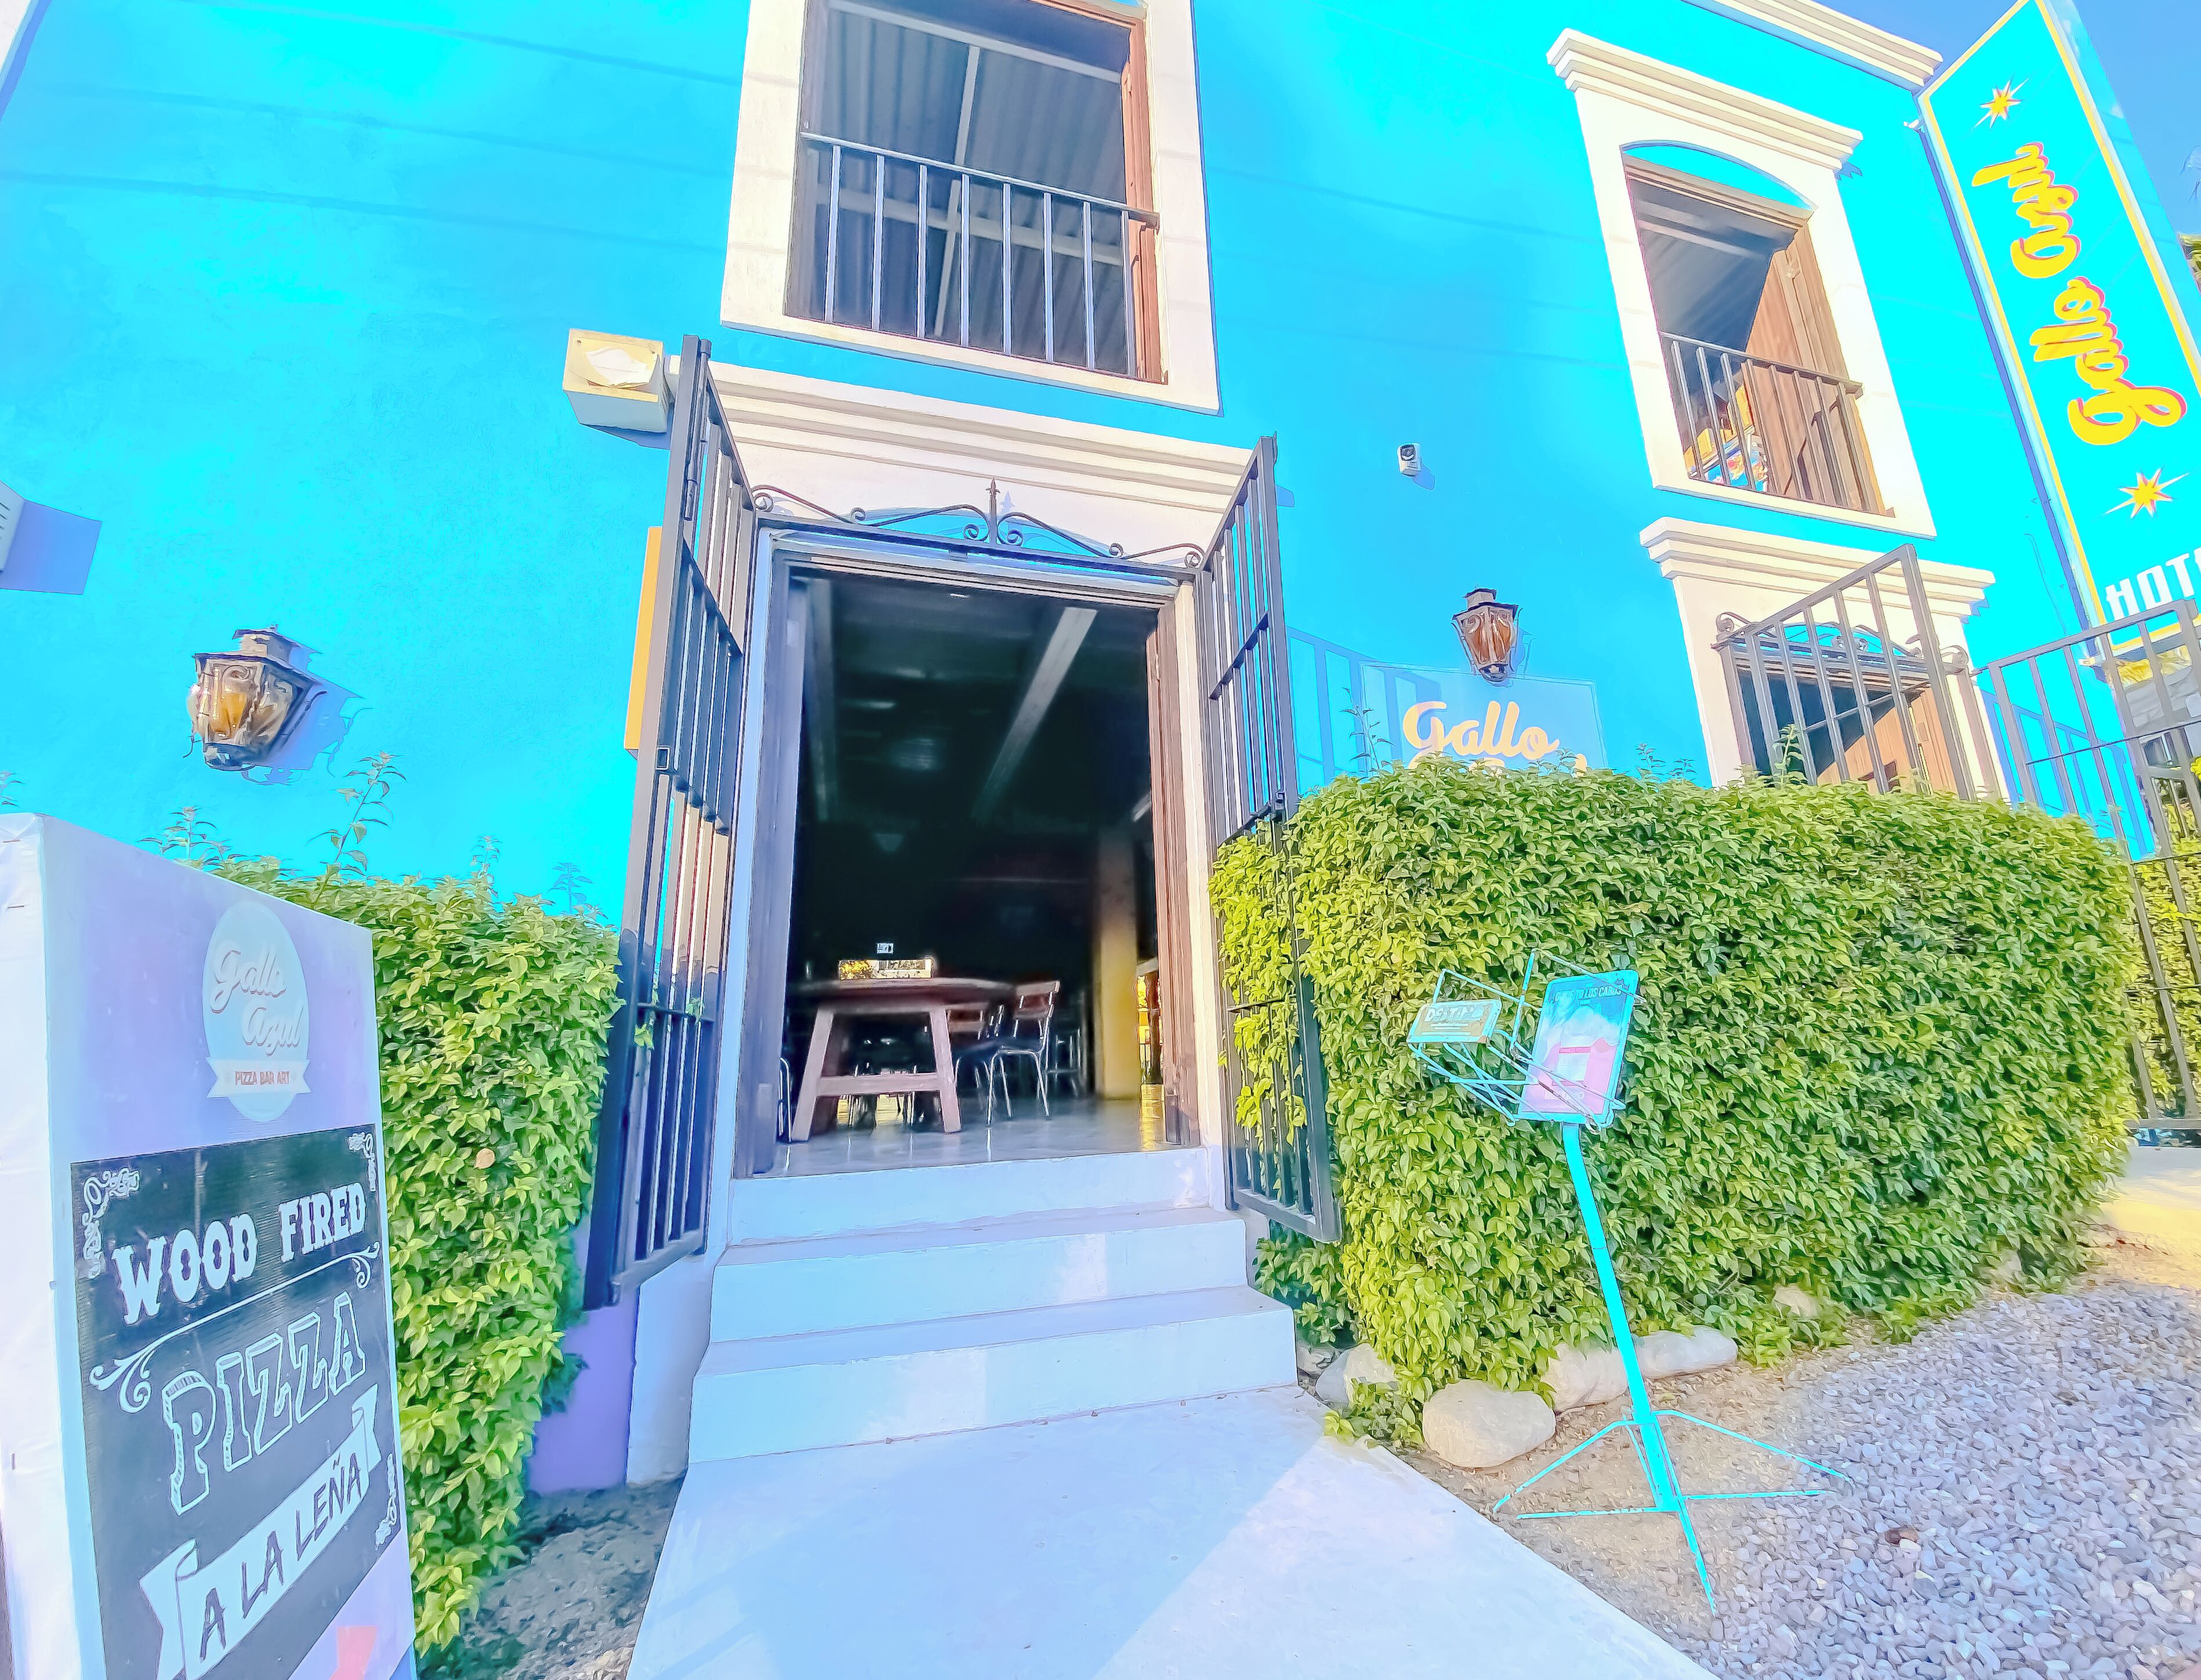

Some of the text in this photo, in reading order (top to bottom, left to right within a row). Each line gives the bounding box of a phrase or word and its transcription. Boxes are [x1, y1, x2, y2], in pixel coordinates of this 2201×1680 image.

[1402, 701, 1560, 770] Gallo
[211, 942, 287, 1014] Gallo
[235, 1071, 258, 1085] PIZZA
[260, 1071, 275, 1085] BAR
[112, 1182, 367, 1325] WOOD FIRED
[161, 1291, 367, 1515] PIZZA
[200, 1453, 364, 1660] A LA LEÑA
